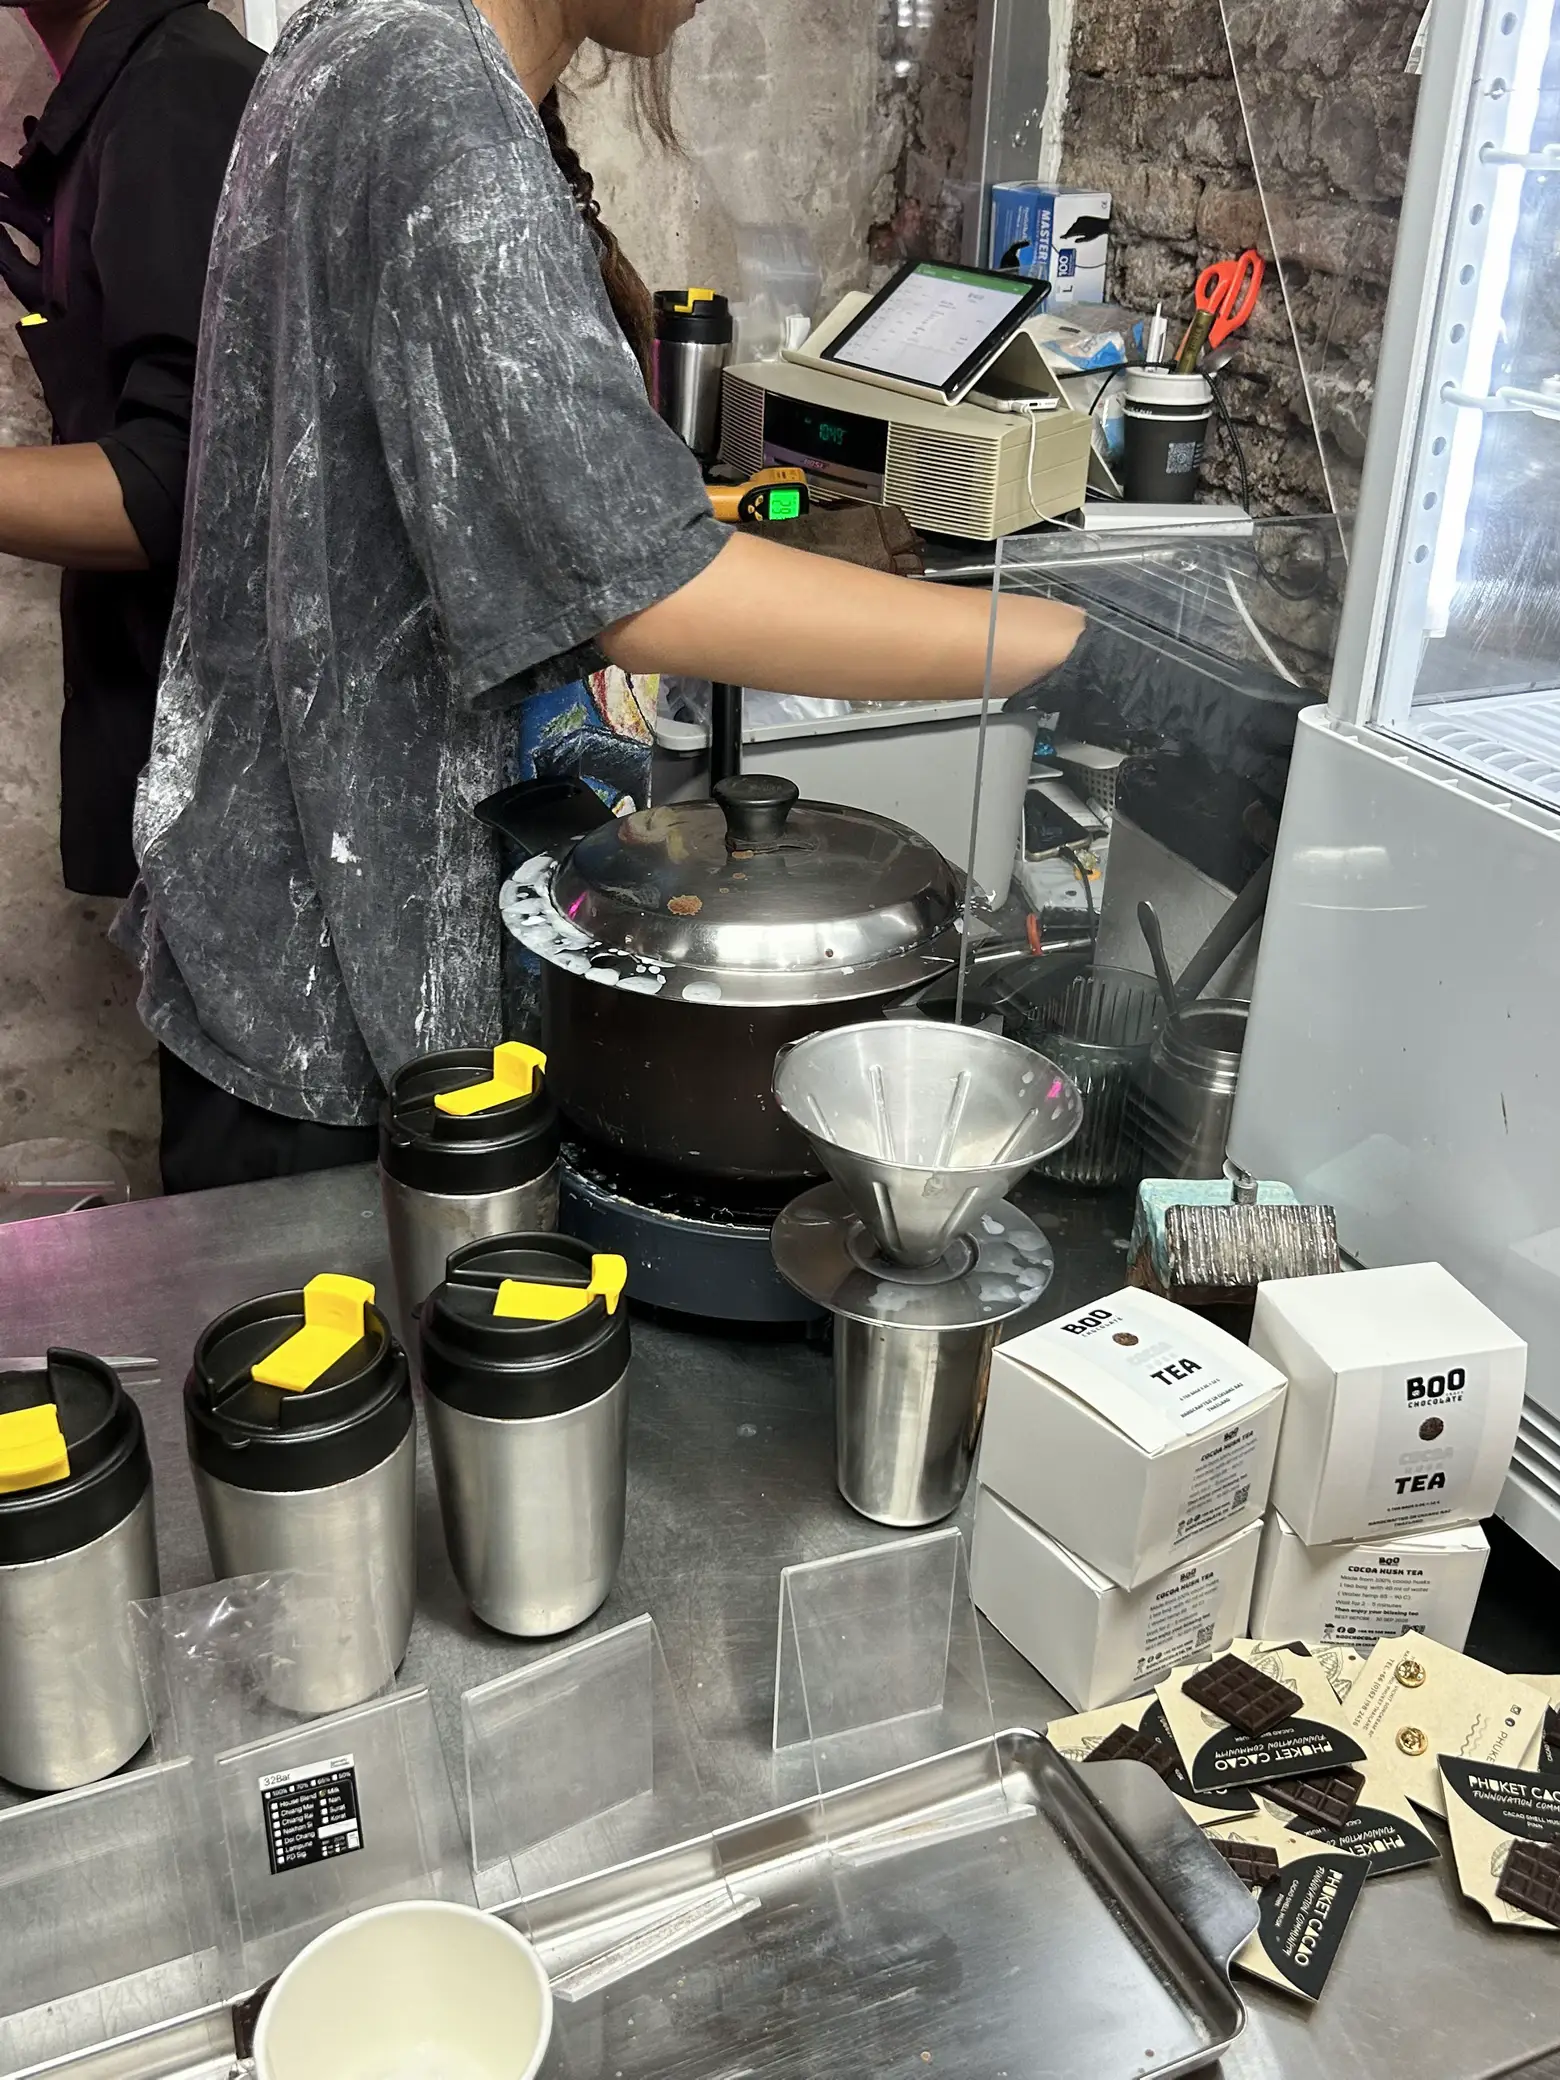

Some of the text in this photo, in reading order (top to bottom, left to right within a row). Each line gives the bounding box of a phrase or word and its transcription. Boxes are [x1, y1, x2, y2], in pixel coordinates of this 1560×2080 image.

[1038, 209, 1051, 261] MASTER
[1058, 255, 1069, 277] 100
[1060, 1309, 1113, 1335] BOO
[1081, 1316, 1123, 1338] CHOCOLATE
[1150, 1358, 1202, 1385] TEA
[1407, 1368, 1465, 1401] BOO
[1408, 1395, 1463, 1408] CHOCOLATE
[1399, 1446, 1453, 1466] COCOA
[1395, 1471, 1446, 1494] TEA
[1156, 1586, 1179, 1600] COCOA
[1201, 1571, 1214, 1581] TEA
[1214, 1733, 1327, 1758] FUNNOVATION COMMUNITY
[1215, 1741, 1333, 1771] PHUKET CACAO
[264, 1774, 291, 1786] 32Bar
[1468, 1775, 1527, 1796] PHUKET
[280, 1793, 317, 1807] House Blend
[330, 1804, 346, 1813] Surat
[1473, 1790, 1532, 1808] FUNNOVATION
[281, 1806, 302, 1816] Chiang
[282, 1815, 303, 1826] Chiang
[330, 1813, 346, 1821] Korat
[1503, 1811, 1525, 1820] CACAO
[283, 1824, 306, 1835] Nakhon
[284, 1831, 315, 1844] Doi Chang
[1339, 1825, 1396, 1846] FUNNOVATION
[1349, 1834, 1406, 1857] PHUKET
[1282, 1865, 1325, 1957] FUNNOVATION COMMUNITY
[1295, 1869, 1343, 1966] PHUKET CACAO
